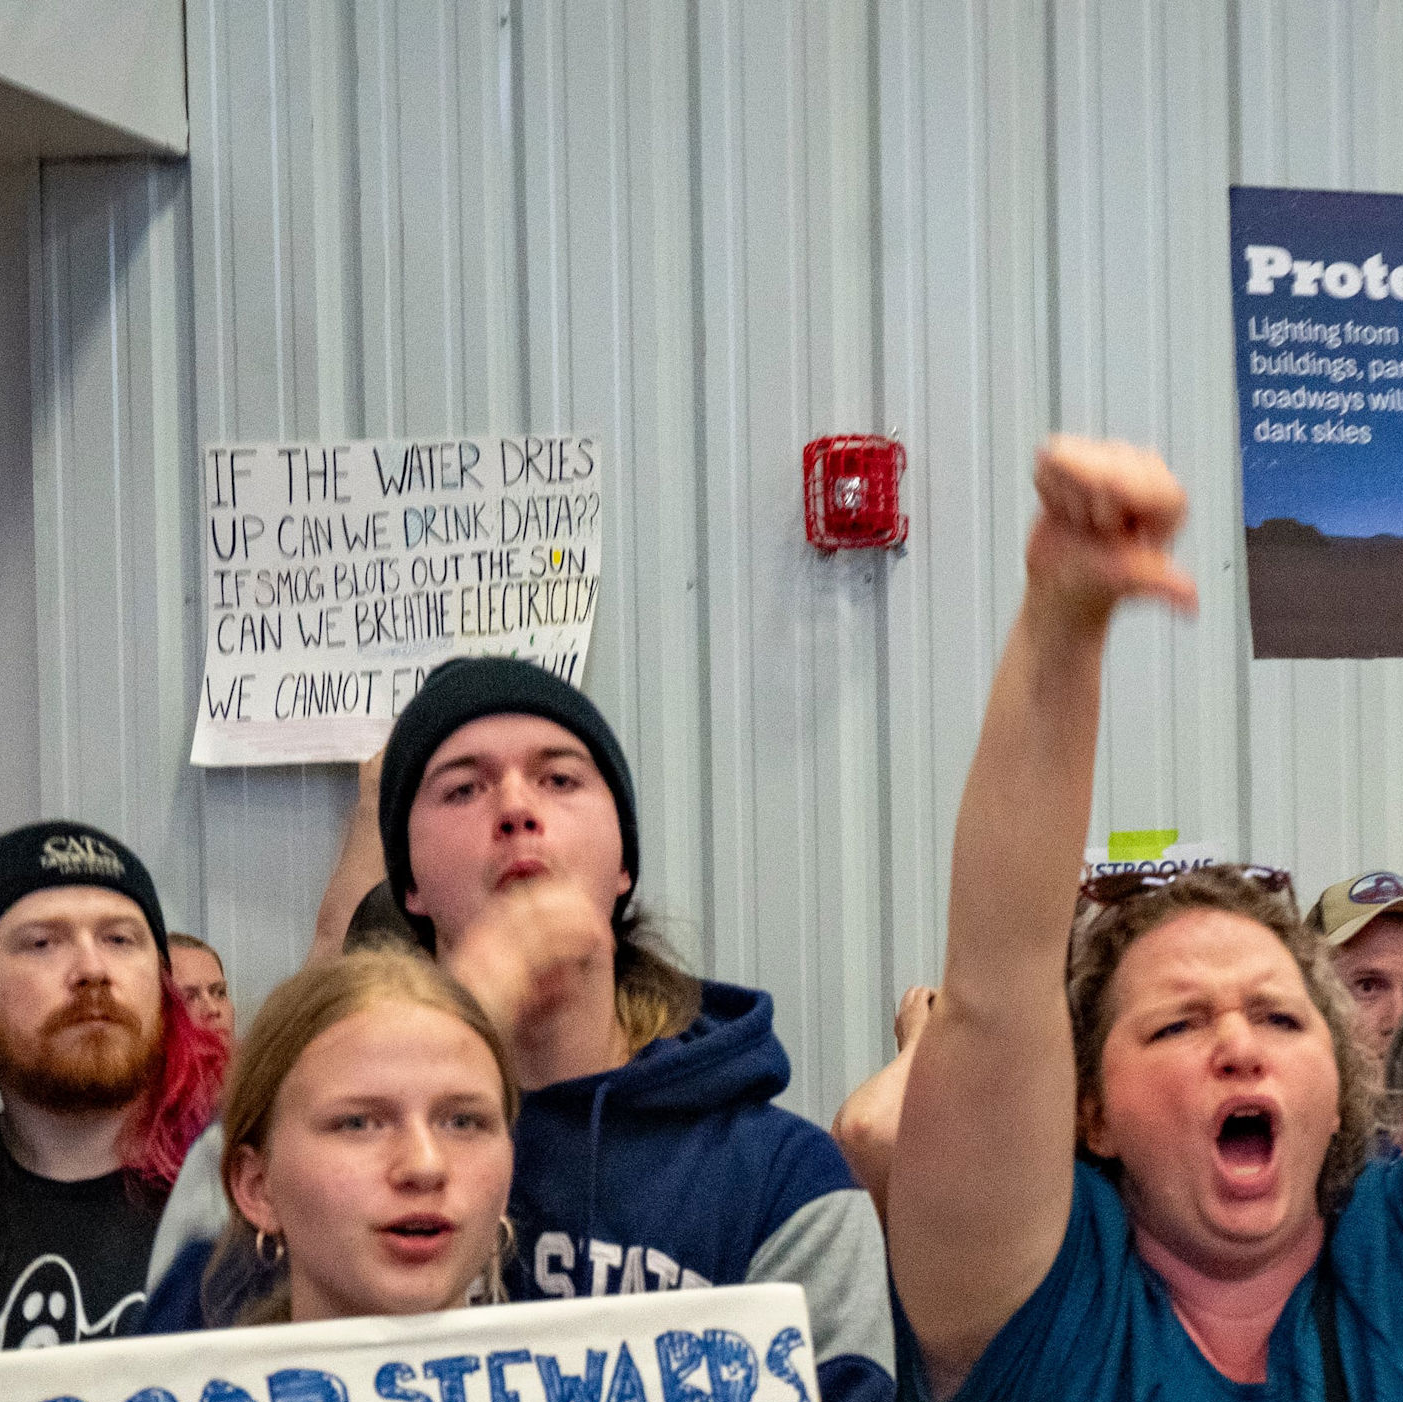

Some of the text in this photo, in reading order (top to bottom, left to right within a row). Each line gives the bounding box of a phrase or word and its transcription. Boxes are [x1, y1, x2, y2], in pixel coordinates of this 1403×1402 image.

[1248, 316, 1342, 349] Lighting
[1344, 320, 1399, 346] from
[1250, 351, 1364, 383] buildings,
[1252, 386, 1366, 415] roadways
[1254, 418, 1373, 445] dark skies
[209, 437, 595, 507] IF THE WATER DRIES
[211, 491, 599, 562] UP CAN WE DRINK DATA??
[213, 545, 587, 611] IF SMOG BLOTS OUT THE SUN
[217, 574, 599, 656] CAN WE BREATHE ELECTRICITY
[206, 673, 257, 722] WE
[275, 668, 383, 720] CANNOT
